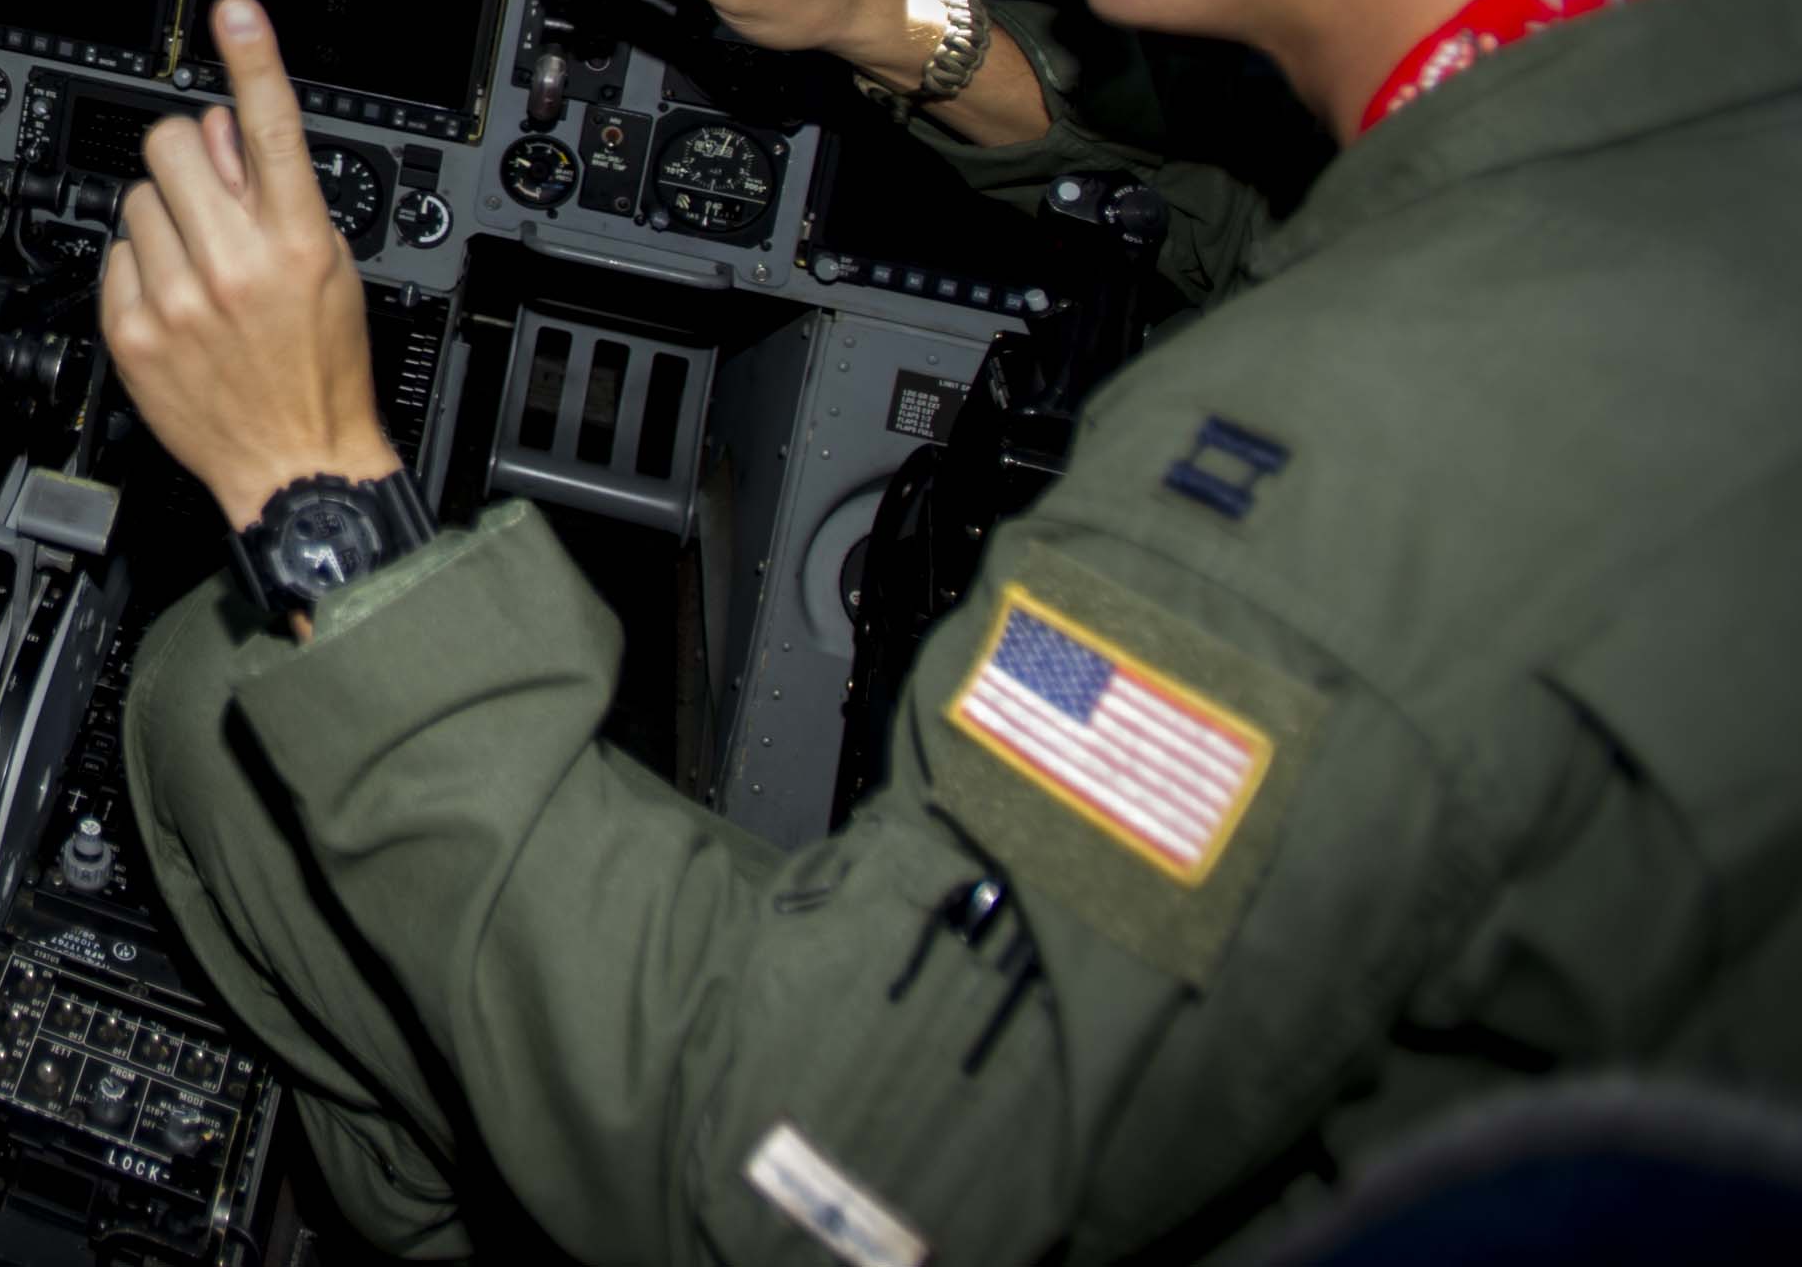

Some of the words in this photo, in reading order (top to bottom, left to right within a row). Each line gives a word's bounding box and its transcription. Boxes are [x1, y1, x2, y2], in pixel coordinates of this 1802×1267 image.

[34, 949, 60, 965] STATUS
[50, 1044, 73, 1059] JETT
[112, 1046, 128, 1059] OFF
[109, 1065, 136, 1082] PRGM
[156, 1063, 172, 1076] OFF
[202, 1080, 218, 1091] OFF
[178, 1091, 206, 1109] MODE
